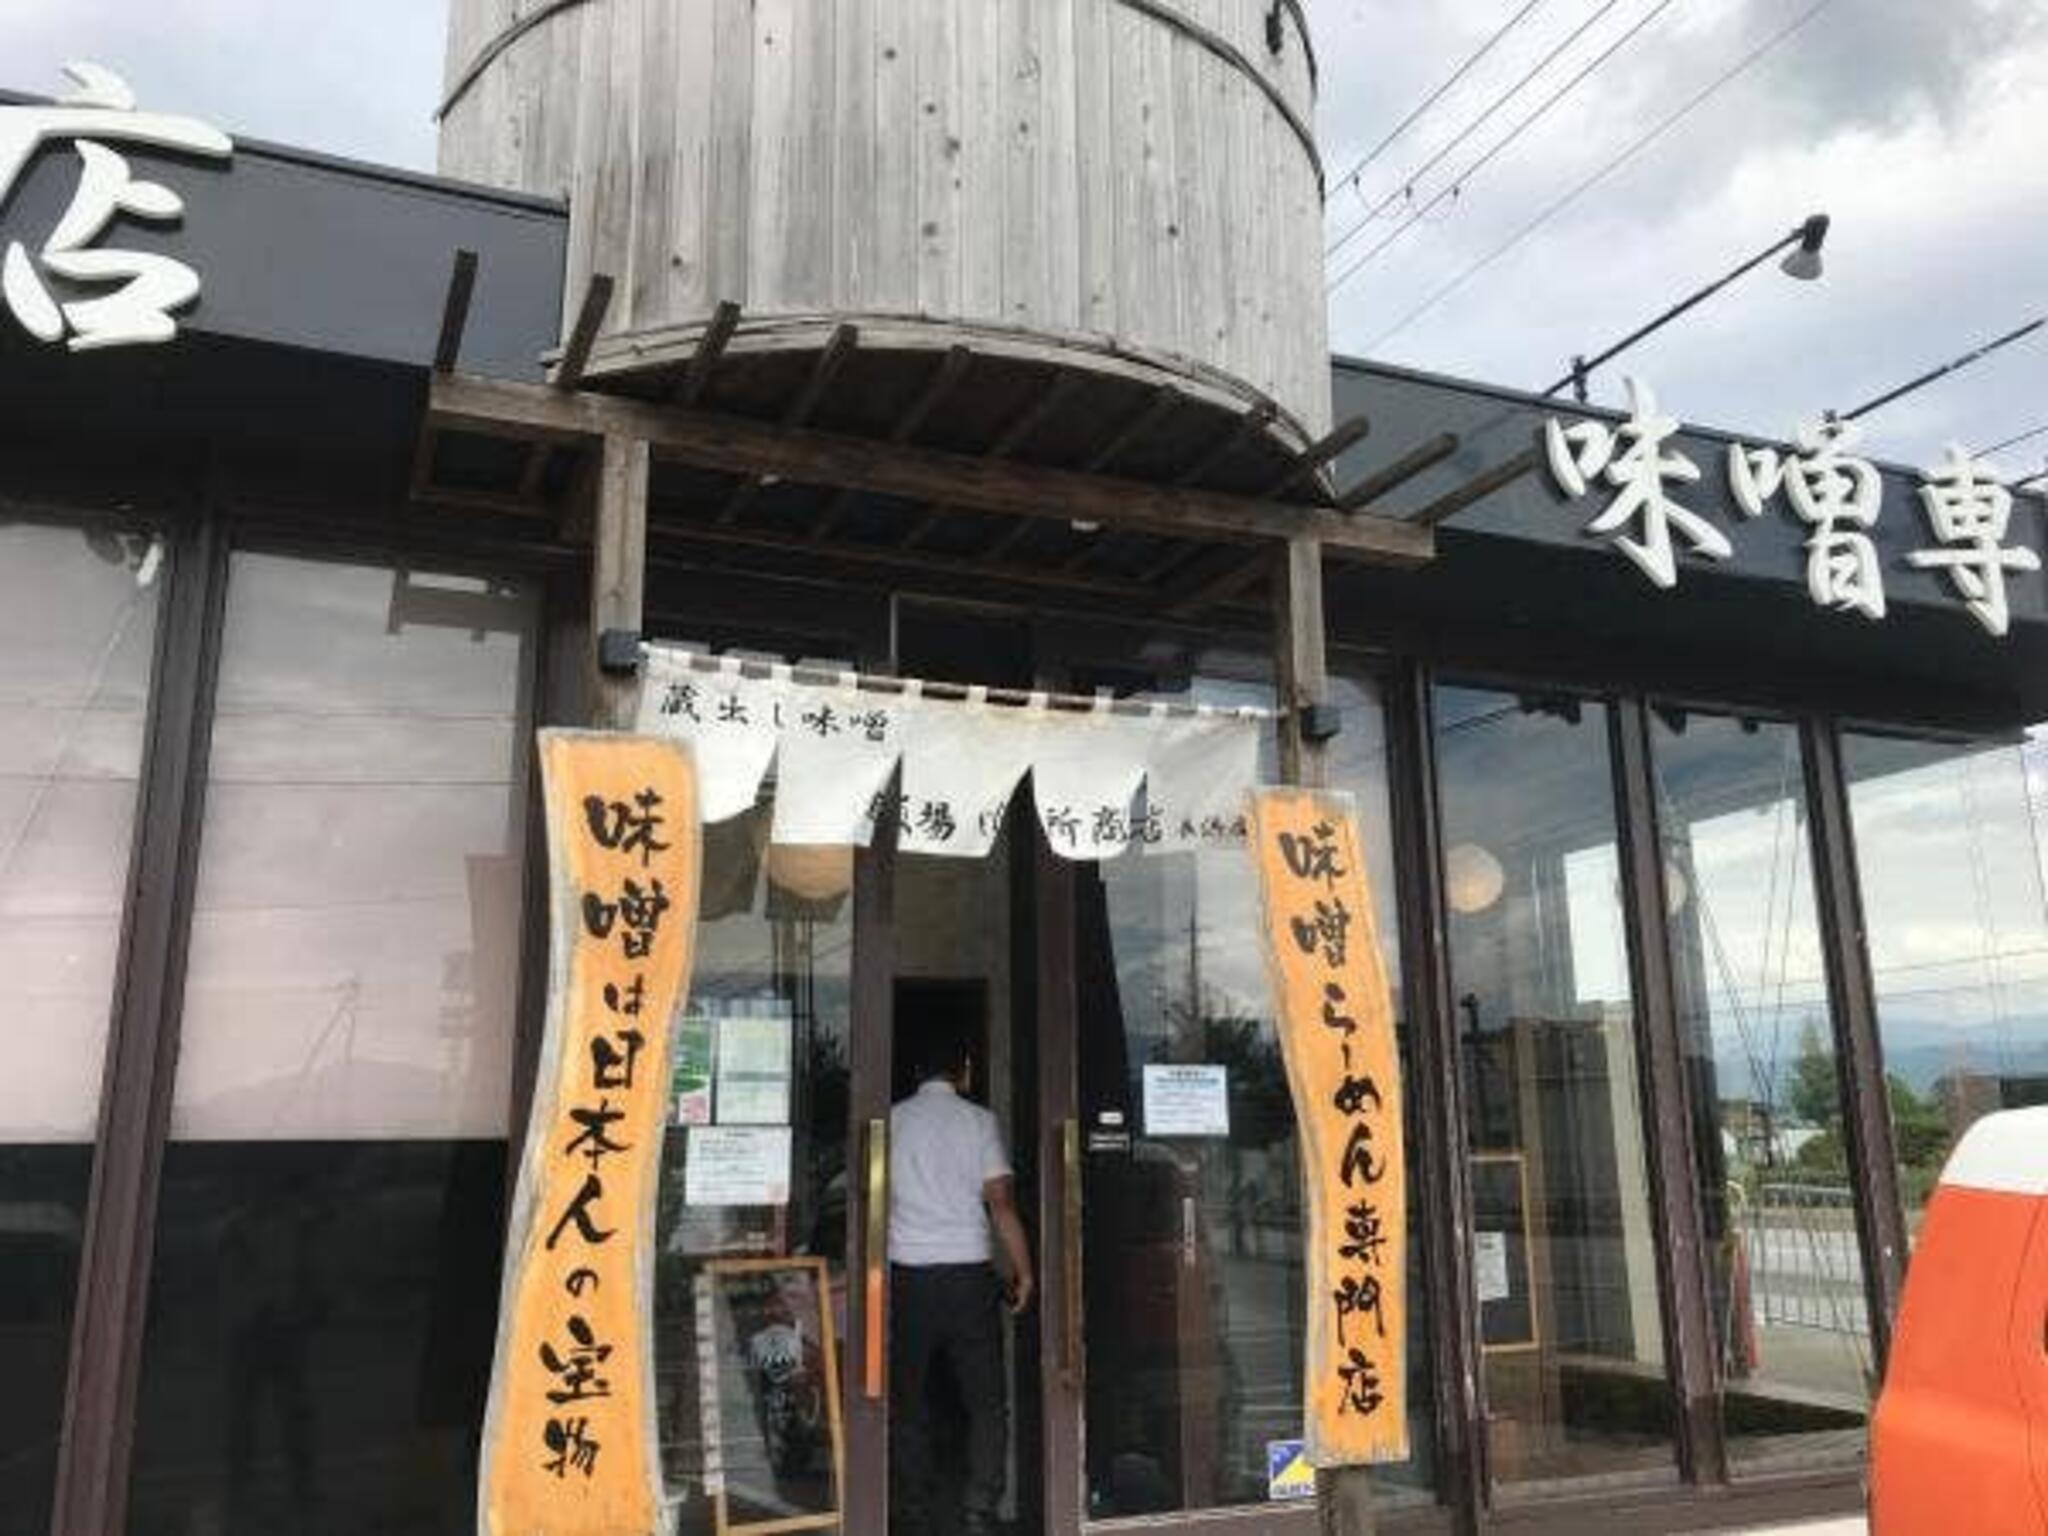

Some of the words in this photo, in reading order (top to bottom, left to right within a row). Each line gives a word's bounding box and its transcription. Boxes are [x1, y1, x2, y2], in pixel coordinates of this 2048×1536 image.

[0, 60, 233, 352] 店
[1545, 376, 2042, 636] 味噌専
[660, 682, 889, 742] 蔵出し味噌
[538, 787, 671, 1479] 味噌は日本人の宝物
[1278, 820, 1387, 1415] 味噌らーめん専門店
